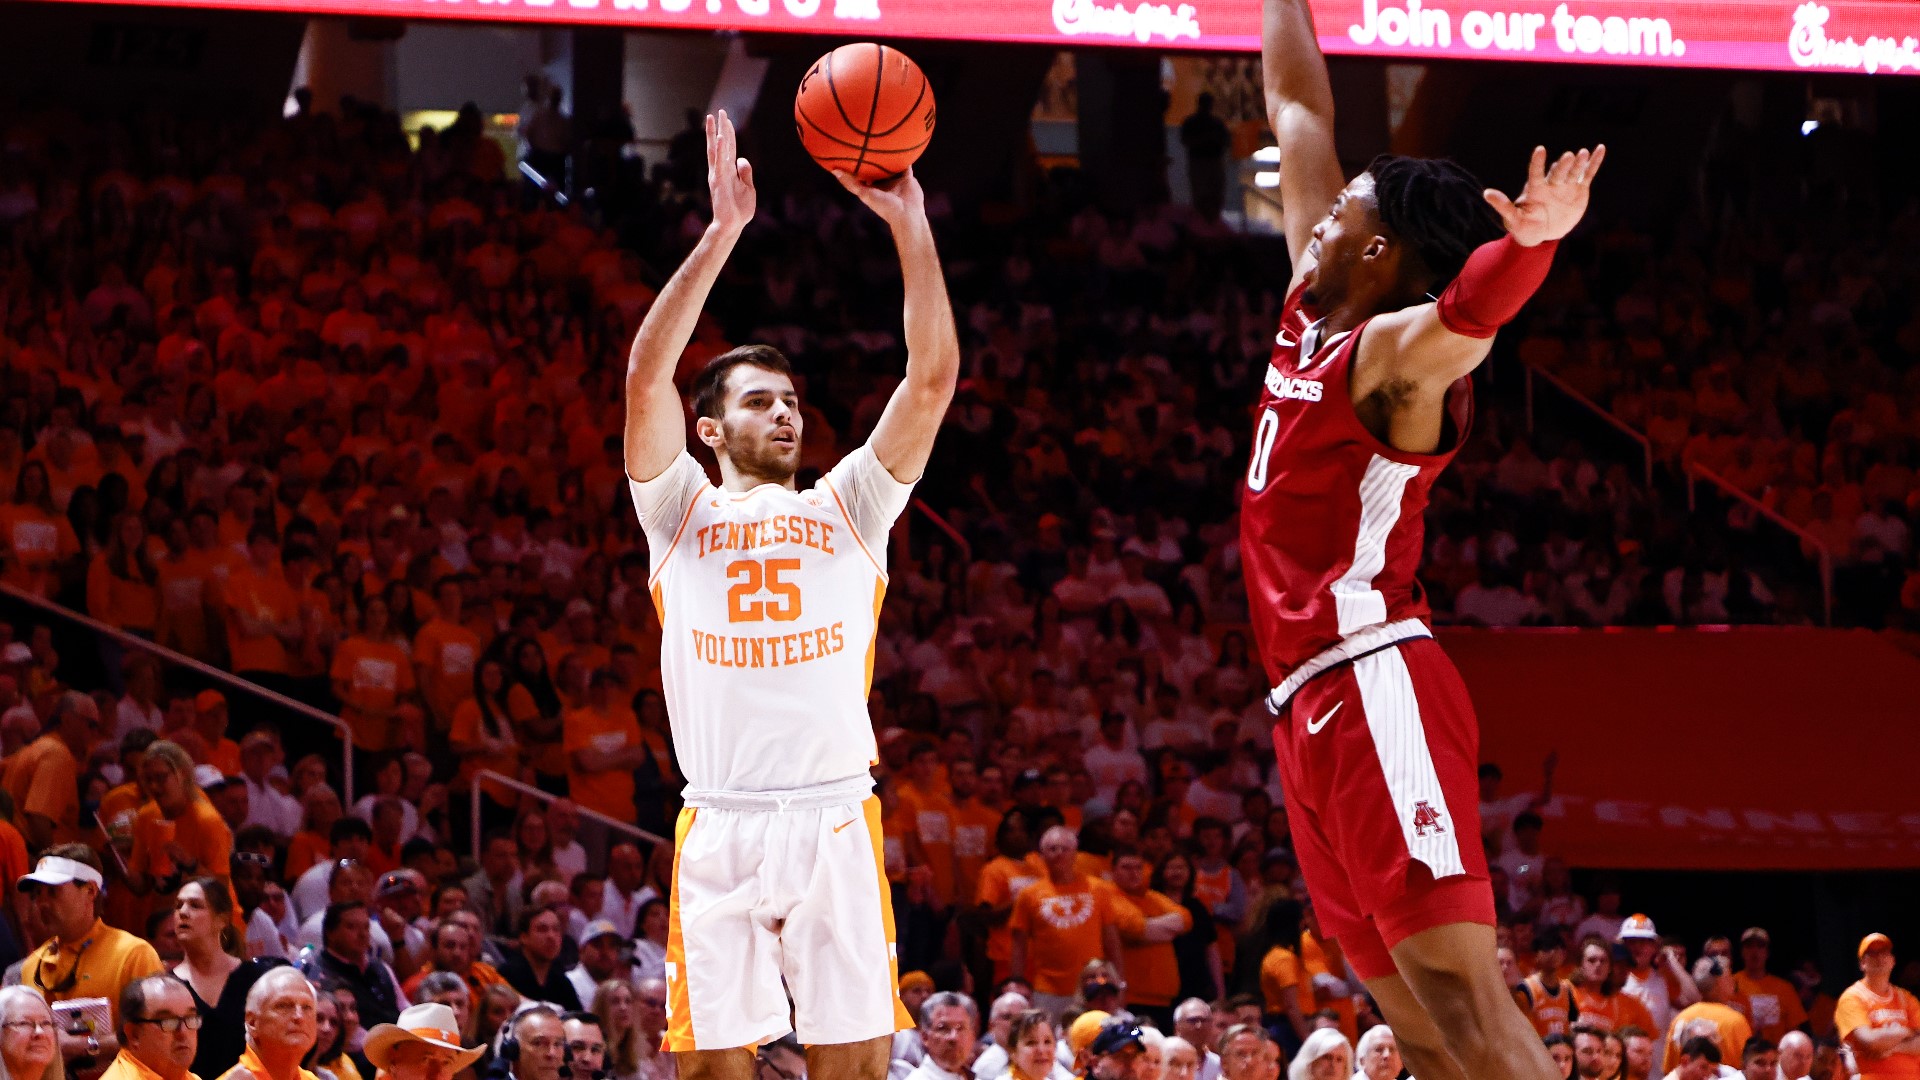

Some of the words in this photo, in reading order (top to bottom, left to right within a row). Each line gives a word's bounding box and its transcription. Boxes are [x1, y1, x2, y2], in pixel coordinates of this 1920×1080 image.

[1348, 0, 1452, 48] Join
[1461, 10, 1546, 50] our
[1551, 2, 1686, 57] team.
[1247, 406, 1280, 494] 0
[696, 514, 835, 559] TENNESSEE
[726, 558, 802, 624] 25
[691, 621, 845, 668] VOLUNTEERS
